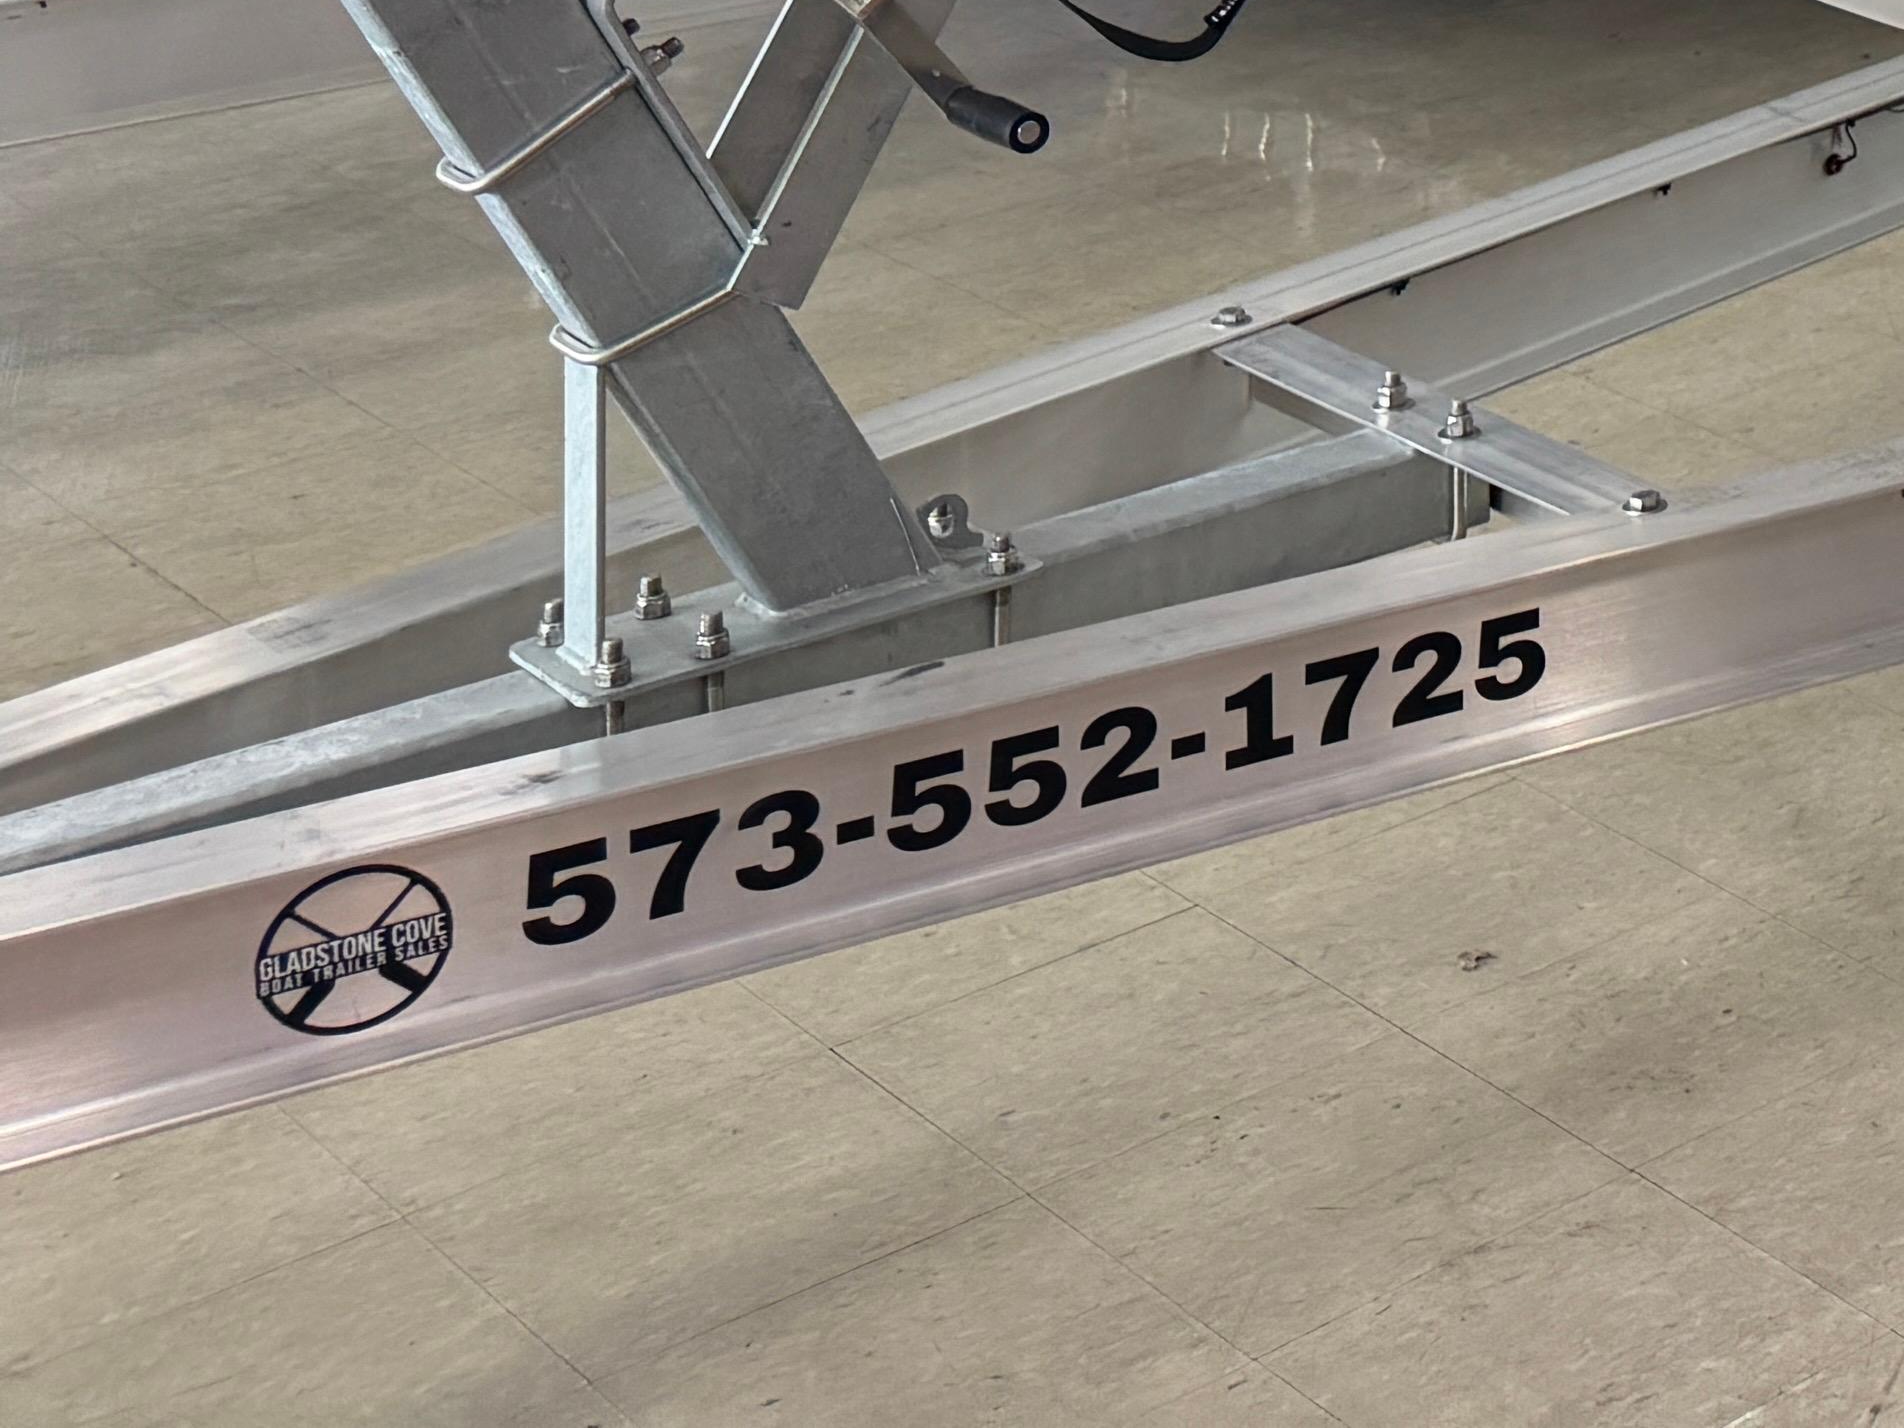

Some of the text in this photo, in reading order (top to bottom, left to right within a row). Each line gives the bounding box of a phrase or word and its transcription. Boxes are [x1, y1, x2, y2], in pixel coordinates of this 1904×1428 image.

[522, 608, 1548, 946] 573-552-1725
[259, 912, 448, 981] GLADSTONE COVE
[259, 935, 449, 997] BOAT TRAILER SALES
